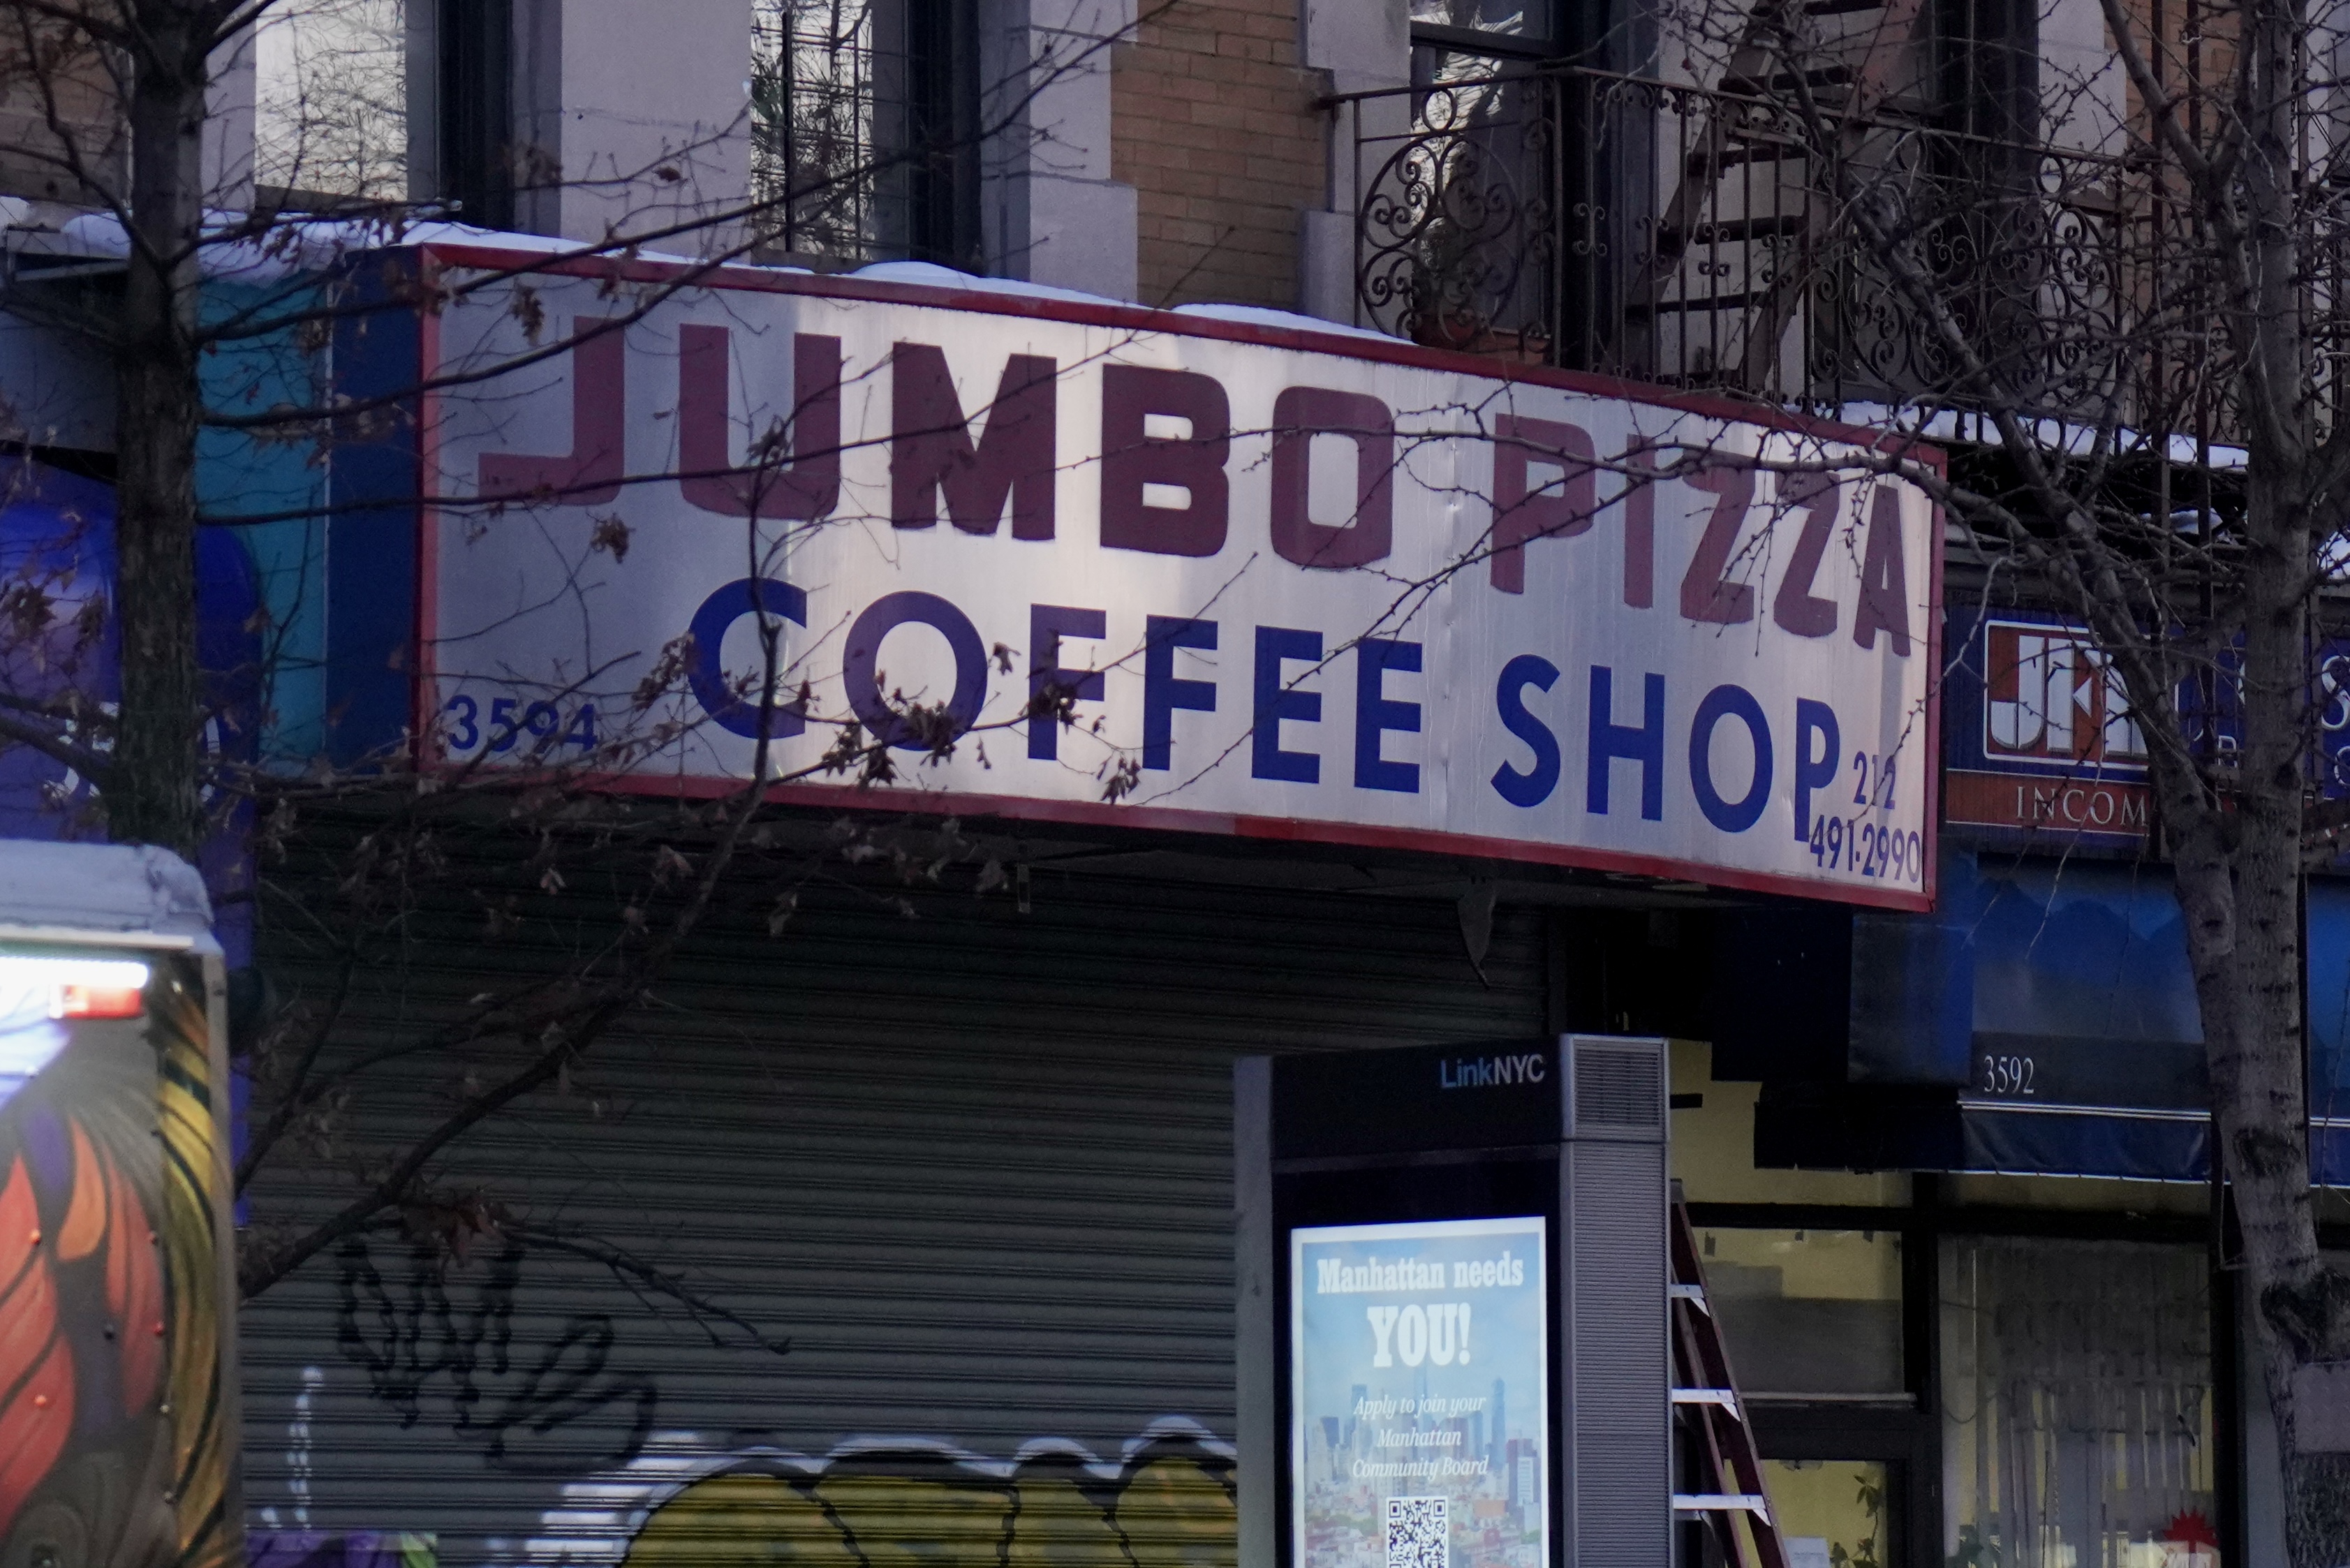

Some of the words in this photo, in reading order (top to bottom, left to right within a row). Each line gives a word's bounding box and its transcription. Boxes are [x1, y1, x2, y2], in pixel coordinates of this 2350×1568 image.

[478, 315, 1394, 571] JUMBO
[1490, 413, 1912, 657] PIZZA
[448, 695, 598, 753] 3594
[687, 577, 1422, 794] COFFEE
[1490, 654, 1840, 843] SHOP
[1854, 750, 1896, 810] 212
[1440, 1053, 1545, 1088] LinkNYC
[1984, 1054, 2034, 1094] 3592
[1317, 1256, 1445, 1294] Manhattan
[1454, 1250, 1523, 1288] needs
[1367, 1302, 1471, 1368] YOU!
[1353, 1394, 1396, 1420] Apply
[1400, 1396, 1415, 1414] to
[1414, 1394, 1446, 1419] join
[1448, 1397, 1486, 1417] your
[1376, 1427, 1462, 1447] Manhattan
[1352, 1457, 1439, 1481] Community
[1441, 1455, 1489, 1475] Board
